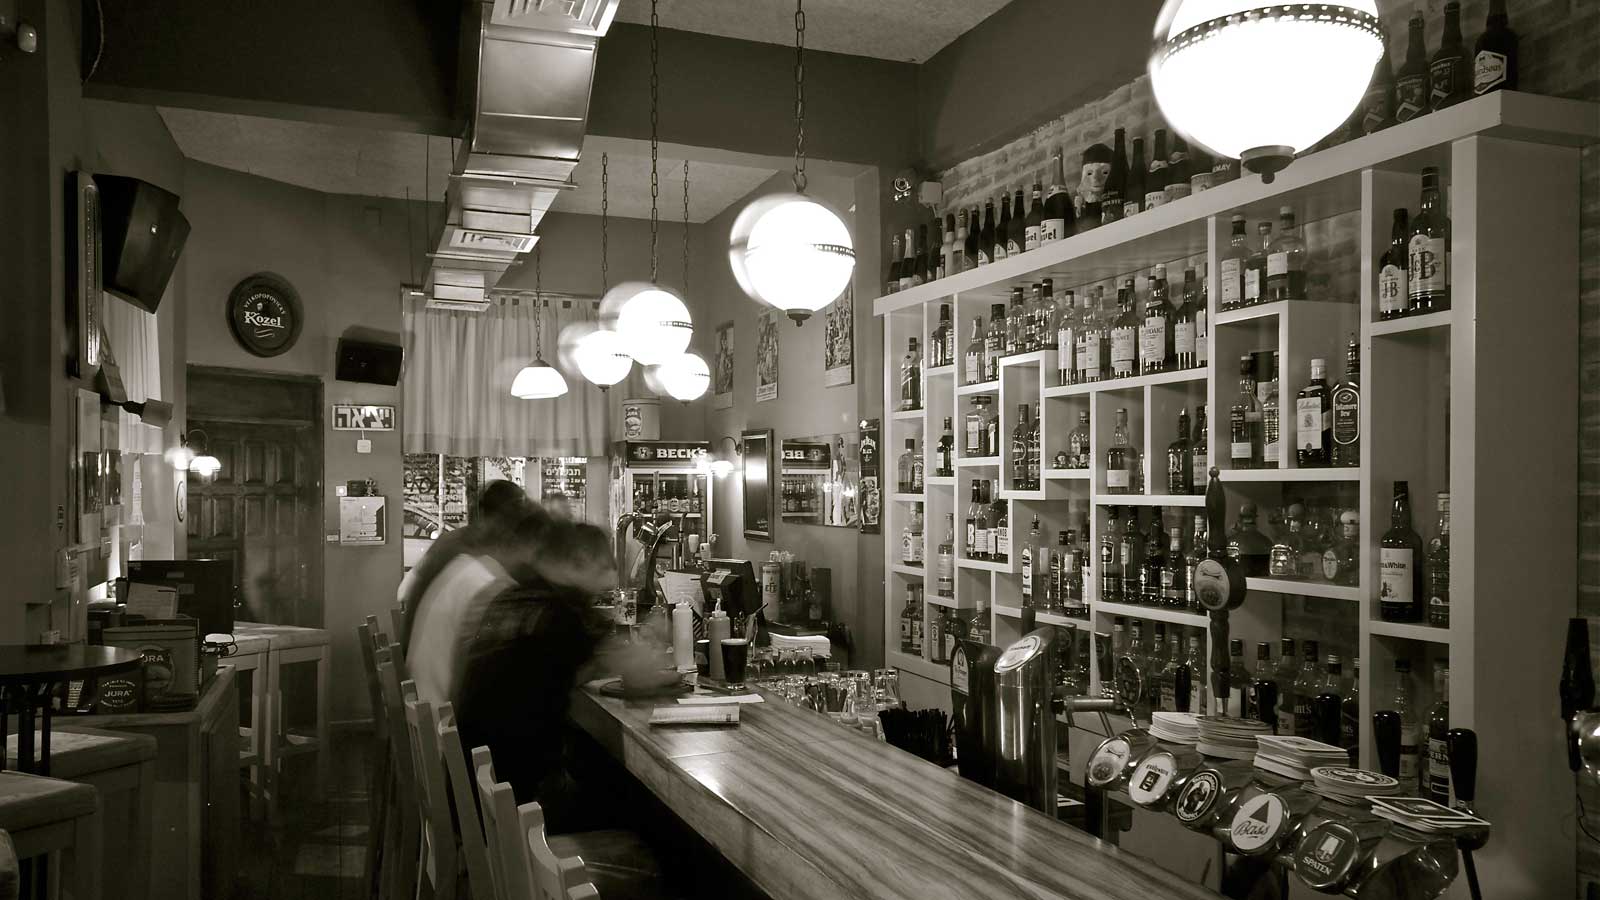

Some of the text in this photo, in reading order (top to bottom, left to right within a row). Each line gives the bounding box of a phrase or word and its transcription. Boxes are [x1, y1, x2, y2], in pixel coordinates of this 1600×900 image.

[244, 311, 285, 328] Kozel
[337, 407, 391, 429] יציאה
[656, 447, 708, 459] BECK'S
[104, 690, 130, 698] JURA
[1234, 821, 1271, 836] Bass
[1302, 856, 1332, 876] SPATEN
